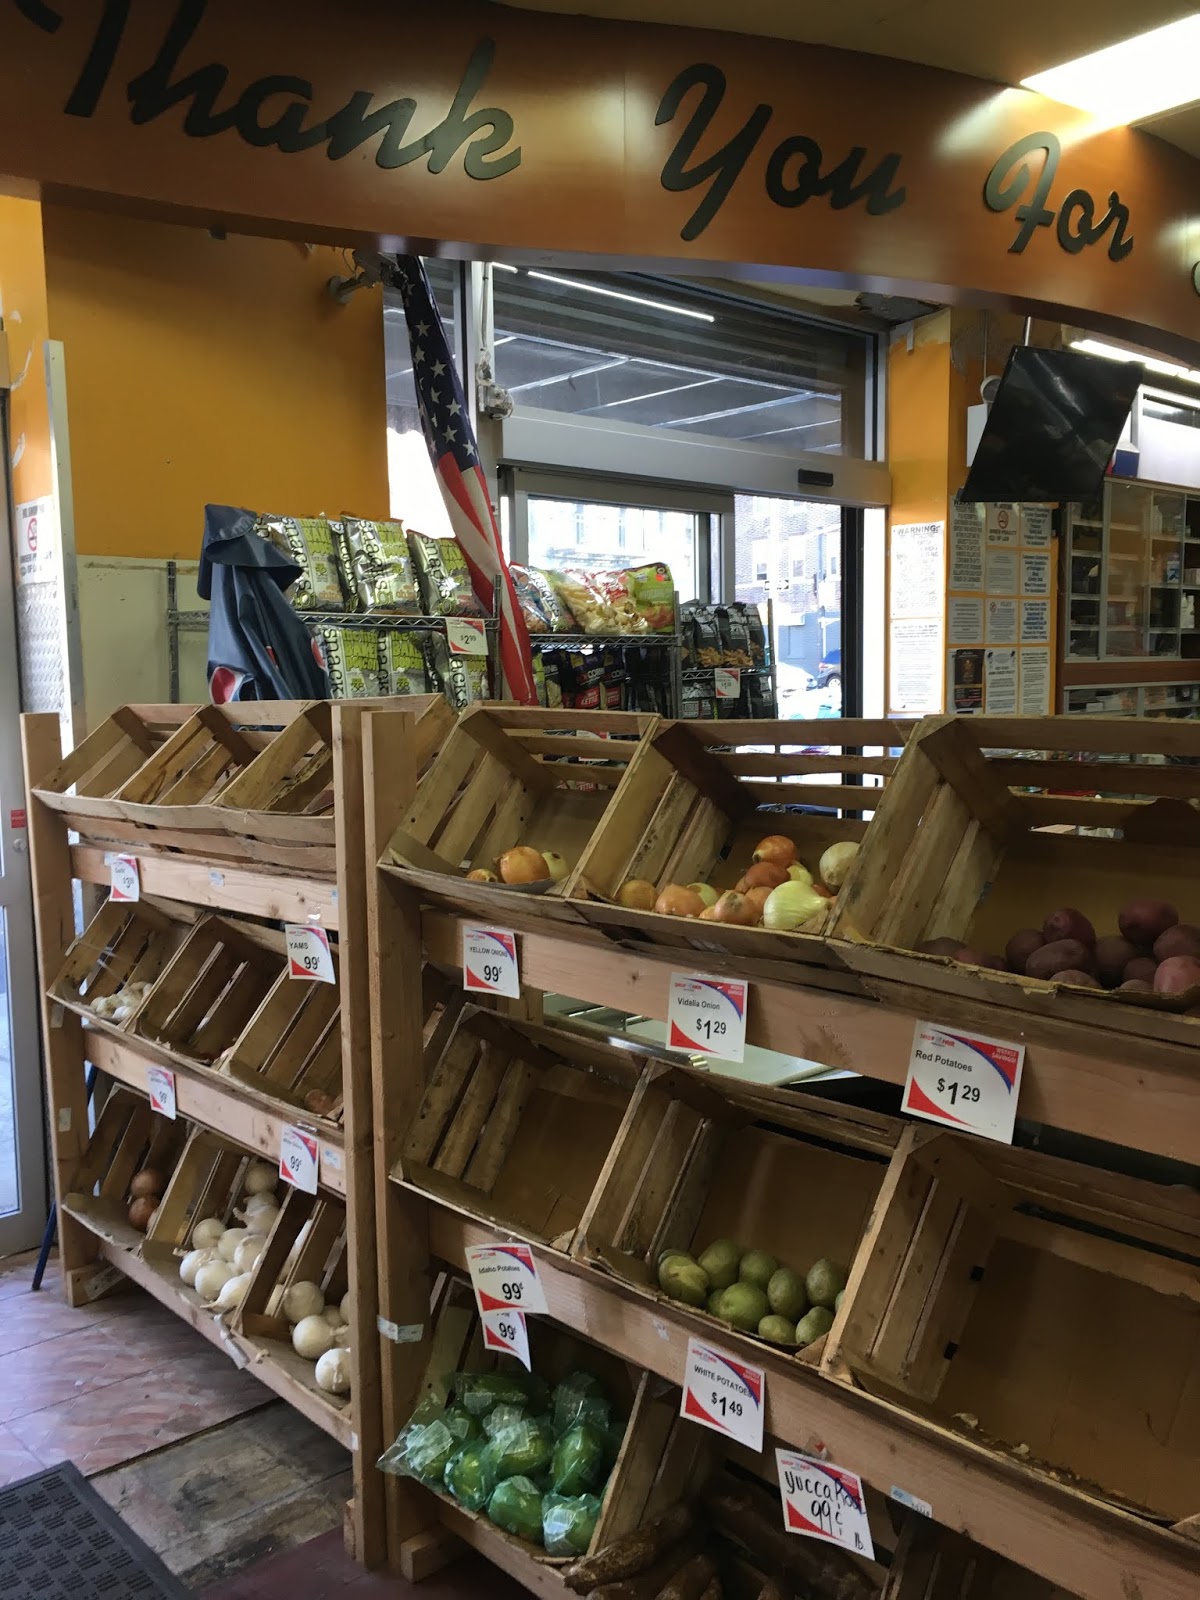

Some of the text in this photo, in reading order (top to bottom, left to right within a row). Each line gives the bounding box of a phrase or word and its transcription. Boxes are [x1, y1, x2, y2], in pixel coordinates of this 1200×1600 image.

[654, 62, 907, 242] You
[983, 130, 1134, 262] For
[323, 628, 345, 699] snack
[289, 941, 309, 950] YAMS
[469, 946, 490, 955] YELLOW
[677, 997, 720, 1011] Vidalia Onion
[915, 1049, 973, 1073] Red Potatoes
[694, 1364, 715, 1381] WHITE
[716, 1375, 753, 1398] POTATOES
